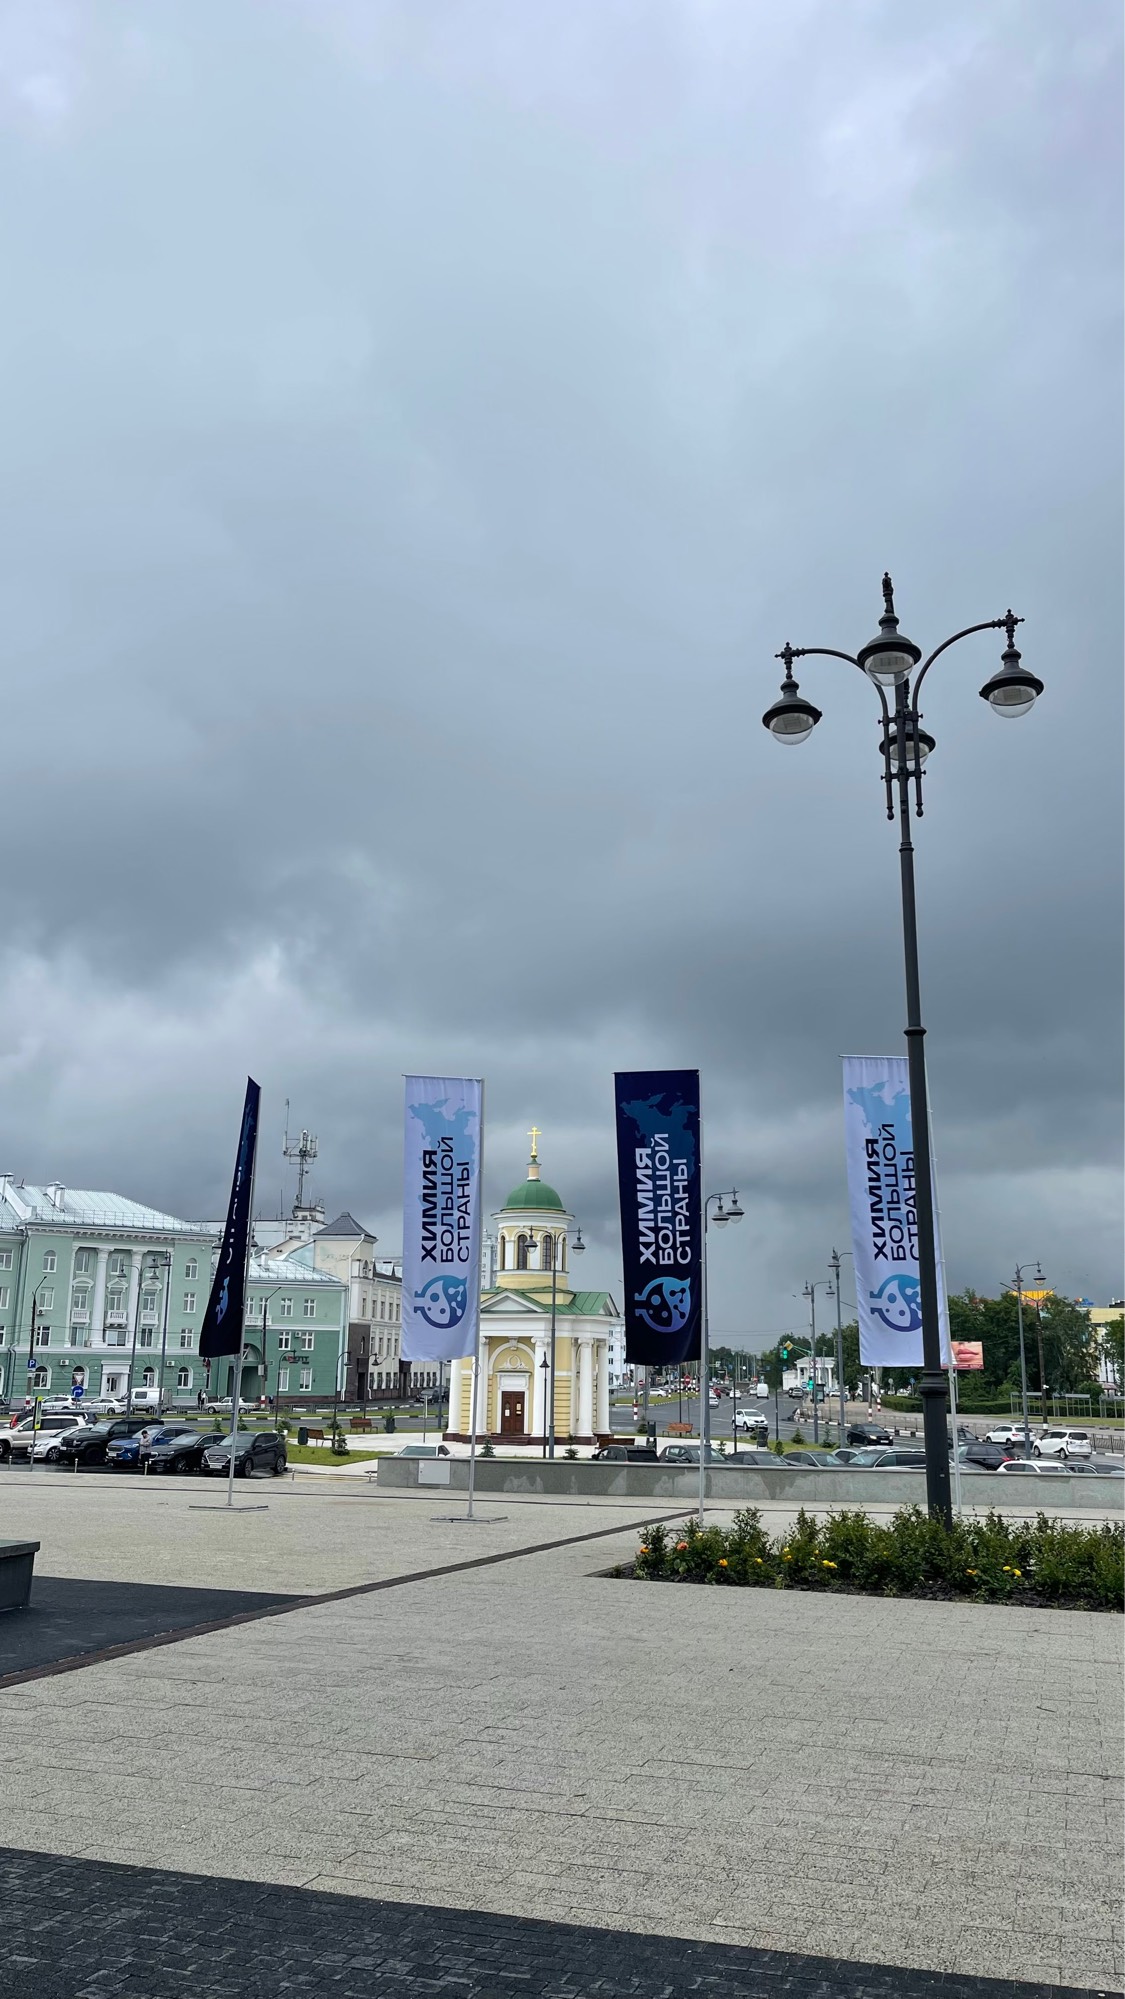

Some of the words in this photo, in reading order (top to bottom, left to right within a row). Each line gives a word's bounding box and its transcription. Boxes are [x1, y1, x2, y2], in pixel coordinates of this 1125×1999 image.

[421, 1149, 438, 1263] ХИМИЯ
[437, 1136, 455, 1263] БОЛЬШОЙ
[456, 1161, 471, 1263] СТРАНЫ
[635, 1147, 657, 1265] ХИМИЯ
[650, 1133, 675, 1265] БОЛЬШОЙ
[673, 1158, 692, 1265] СТРАНЫ
[865, 1138, 889, 1261] ХИМИЯ
[878, 1123, 907, 1261] БОЛЬШОЙ
